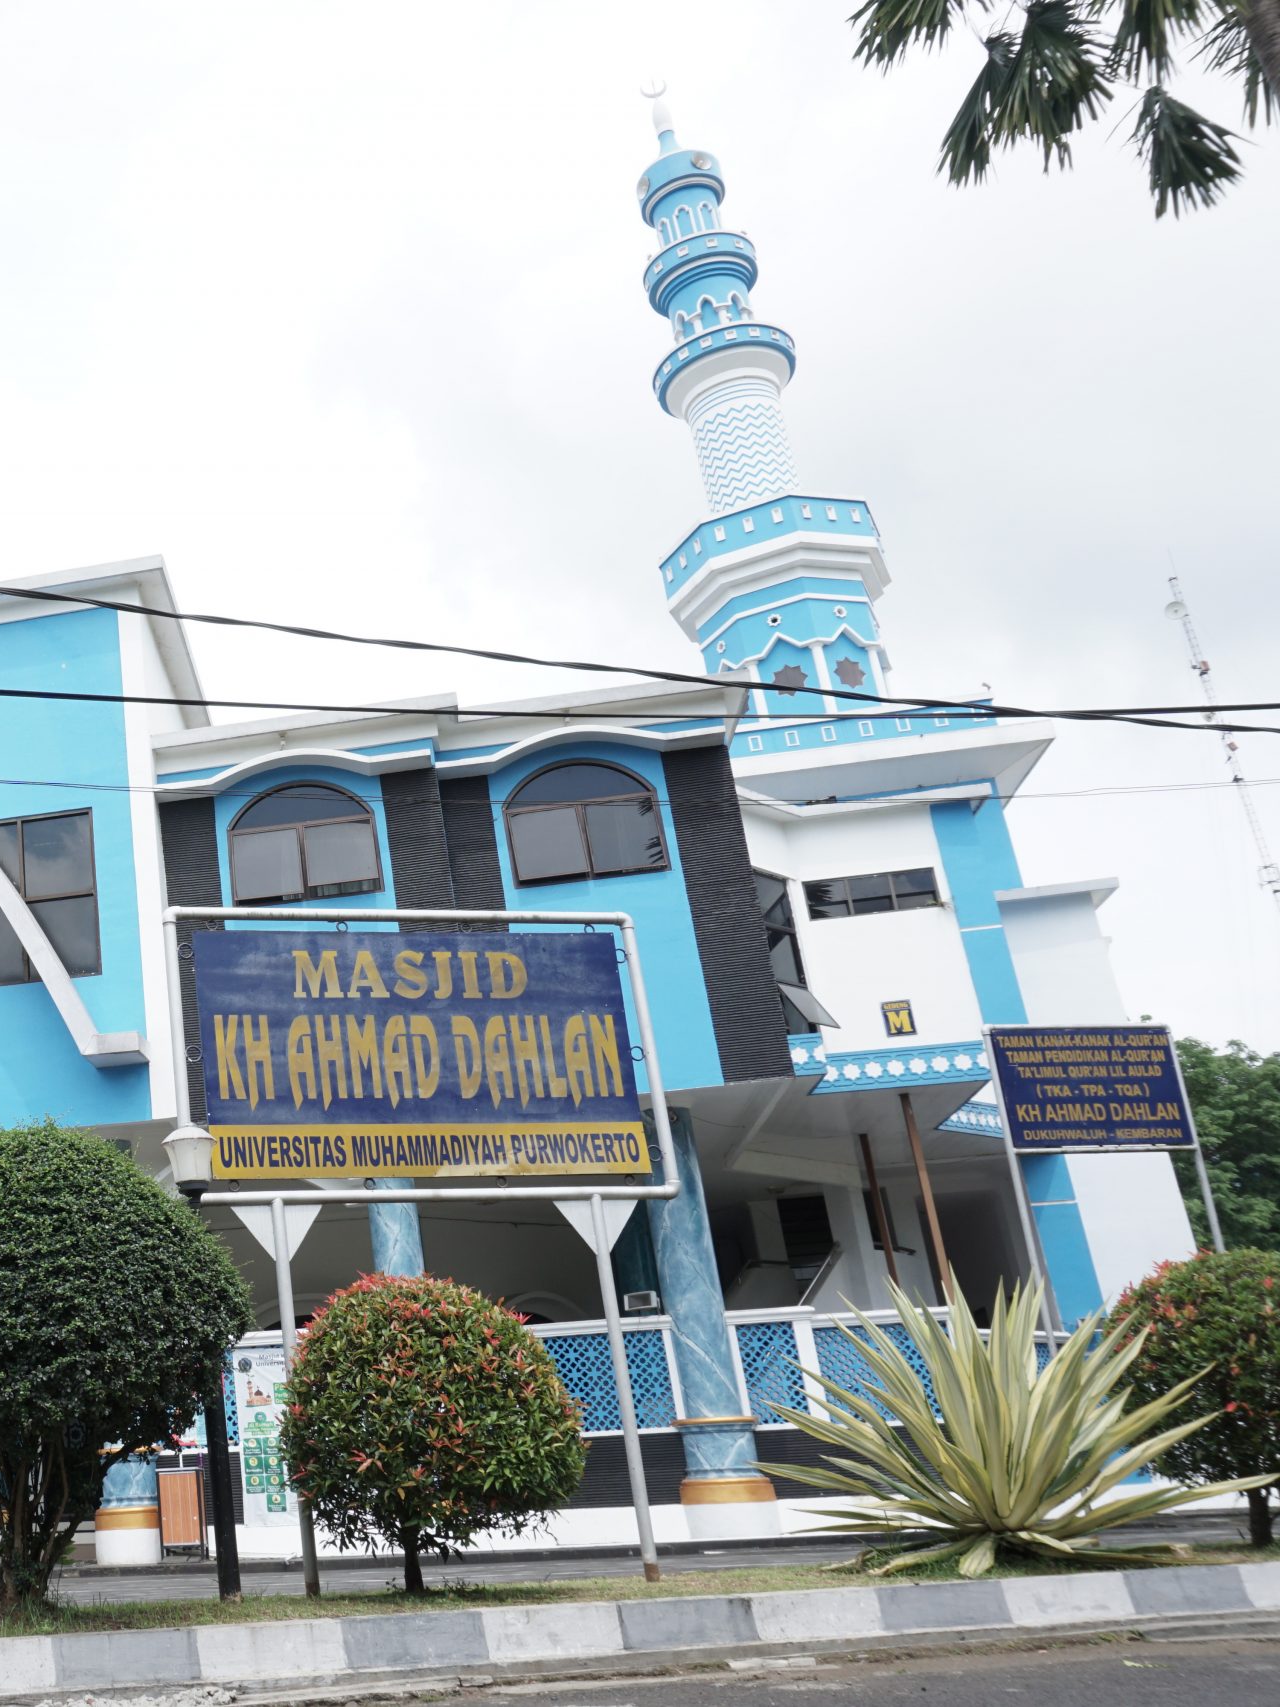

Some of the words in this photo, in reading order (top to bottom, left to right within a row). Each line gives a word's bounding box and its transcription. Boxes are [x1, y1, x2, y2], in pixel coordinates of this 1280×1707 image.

[292, 950, 528, 999] MASJID
[886, 1010, 913, 1033] M
[996, 1036, 1034, 1048] TAMAN
[1036, 1035, 1111, 1047] KANAK-KANAK
[1114, 1034, 1169, 1047] AL-QUR'AN
[213, 1014, 275, 1110] KH
[288, 1014, 441, 1110] AHMAD
[451, 1014, 625, 1110] DAHLAN
[1006, 1051, 1043, 1064] TAMAN
[1045, 1050, 1109, 1063] PENDIDIKAN
[1111, 1050, 1166, 1063] AL-QUR'AN
[1018, 1066, 1066, 1079] TA'LIMUL
[1068, 1066, 1108, 1079] QUR'AN
[1109, 1066, 1126, 1078] LIL
[1128, 1065, 1163, 1077] AULAD
[1043, 1085, 1072, 1097] TKA
[1080, 1084, 1106, 1097] TPA
[1016, 1104, 1042, 1122] KH
[1045, 1104, 1106, 1122] AHMAD
[1109, 1103, 1181, 1121] DAHLAN
[1023, 1129, 1107, 1141] DUKUHWALUH
[1116, 1128, 1182, 1140] KEMBARAN
[220, 1135, 347, 1168] UNIVERSITAS
[352, 1133, 508, 1167] MUHAMMADIYAH
[511, 1131, 640, 1165] PURWOKERTO
